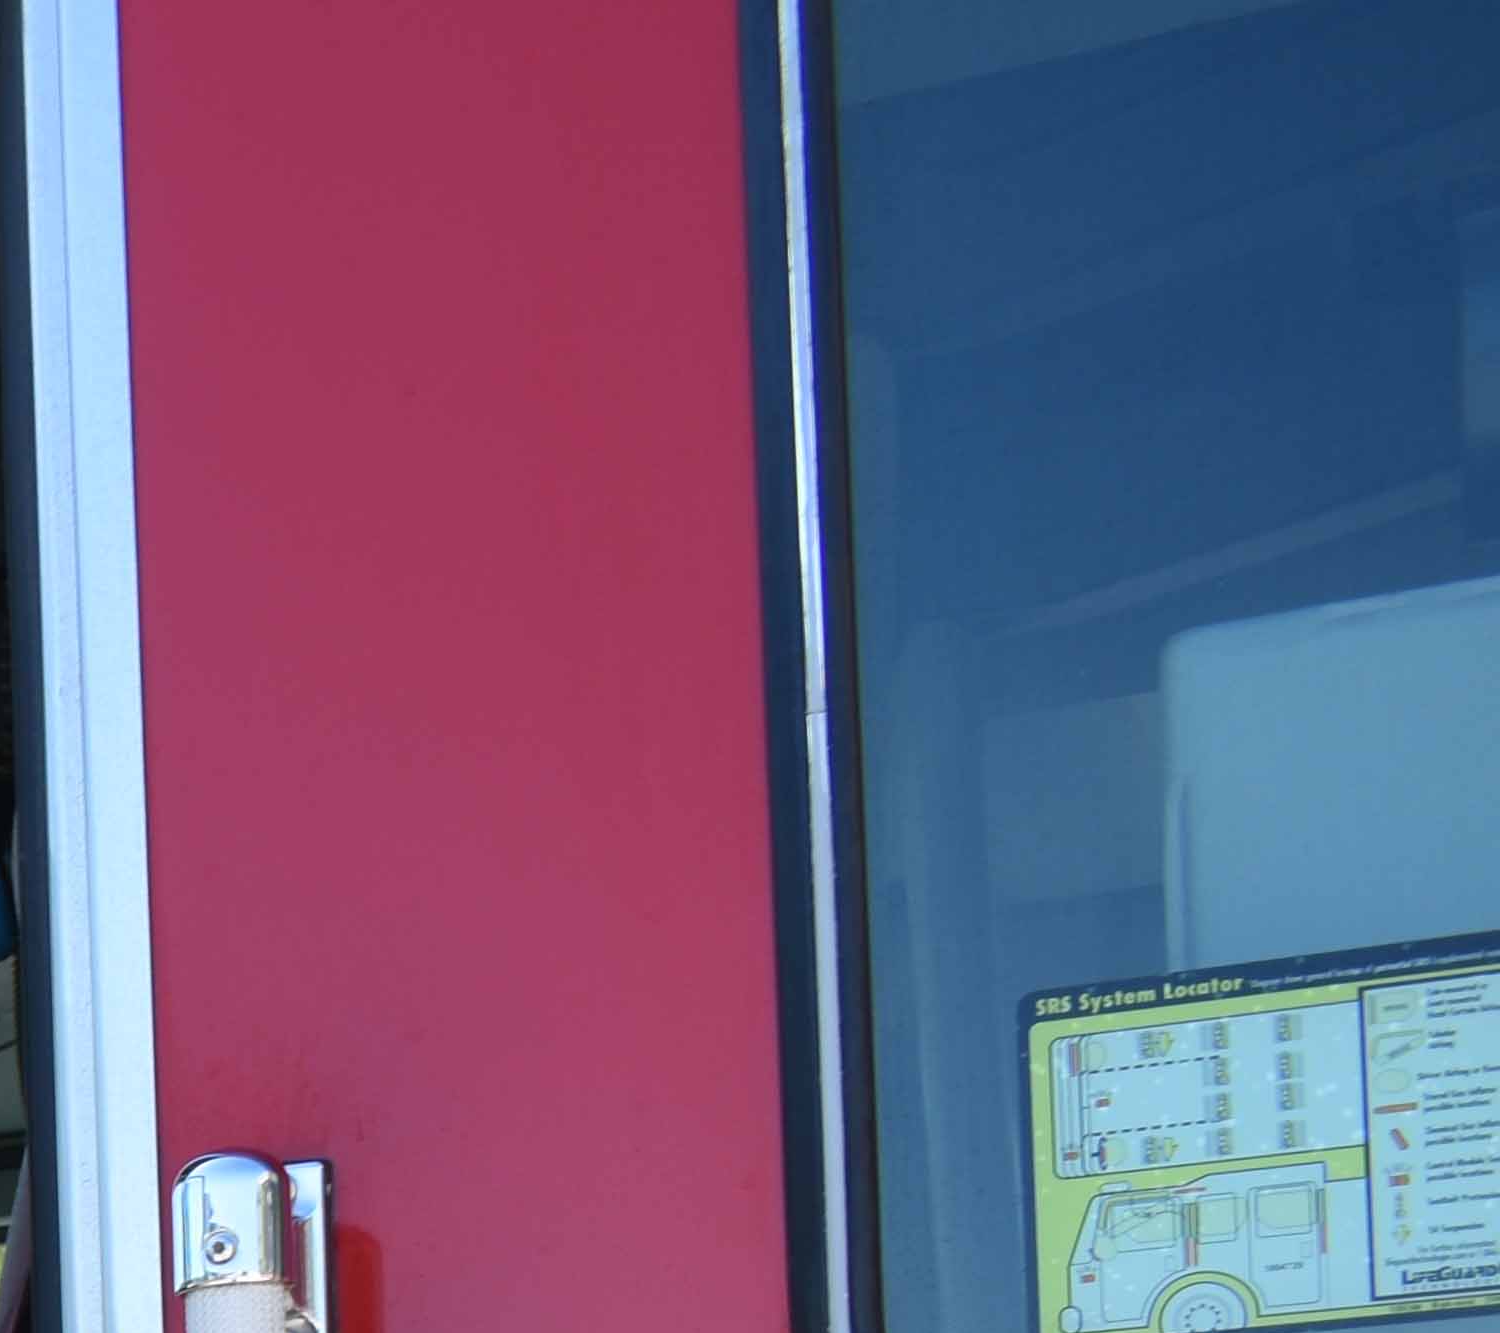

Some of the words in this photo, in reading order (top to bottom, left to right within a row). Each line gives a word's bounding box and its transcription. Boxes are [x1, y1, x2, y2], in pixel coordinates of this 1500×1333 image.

[1035, 996, 1072, 1016] SRS
[1078, 989, 1157, 1013] System
[1163, 978, 1244, 1000] Locator
